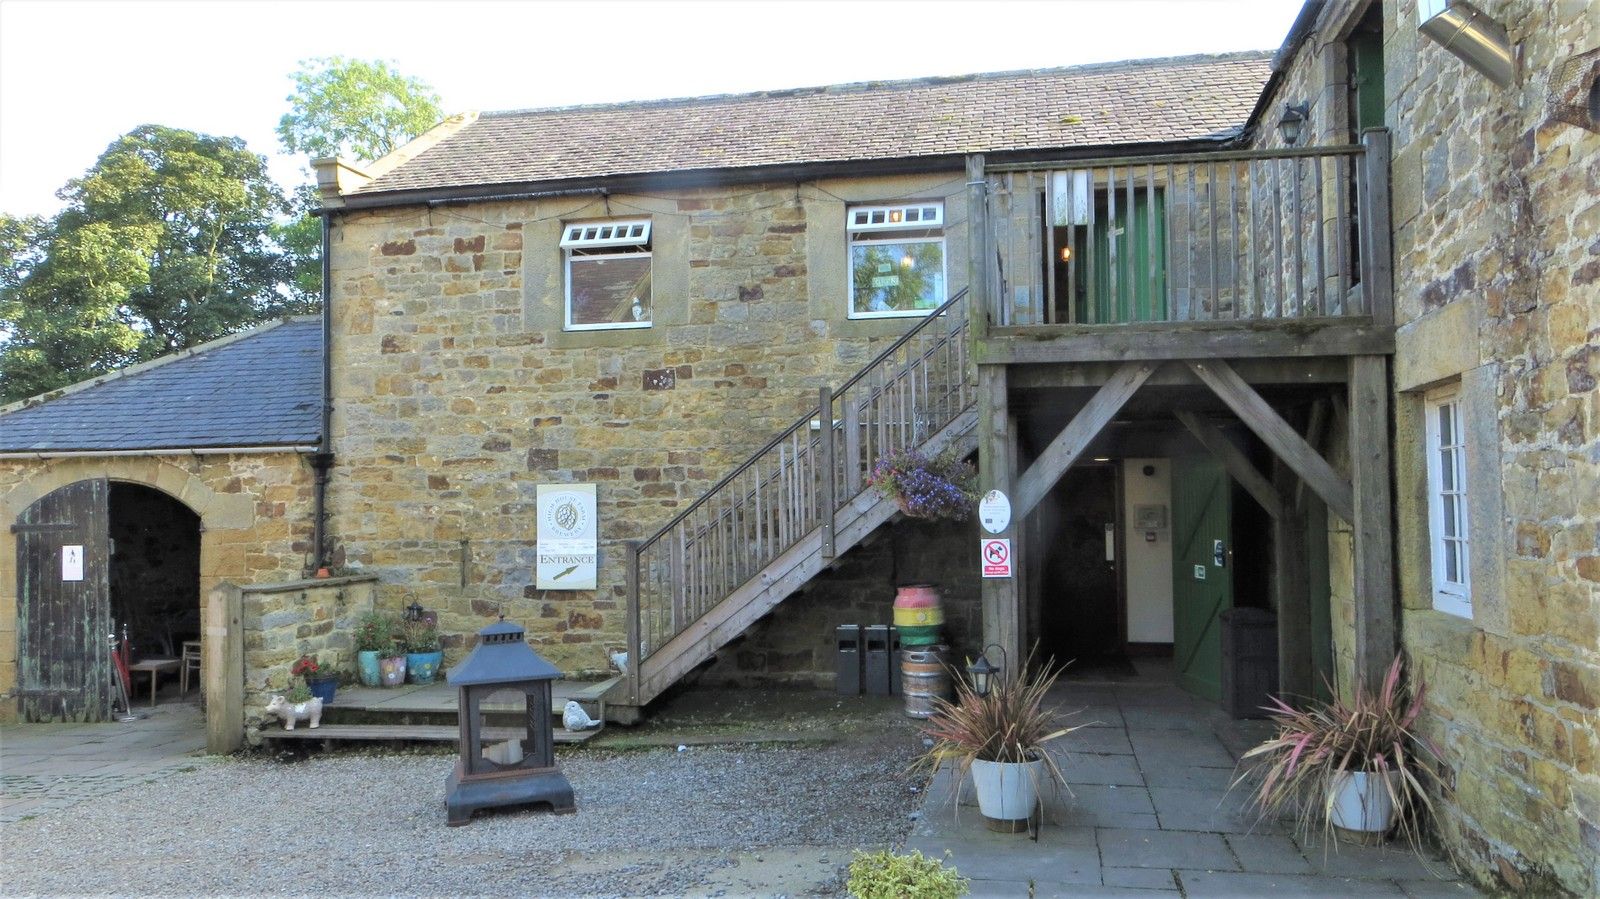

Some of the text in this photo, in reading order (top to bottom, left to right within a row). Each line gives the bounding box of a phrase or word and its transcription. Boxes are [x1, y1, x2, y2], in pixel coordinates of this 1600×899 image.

[555, 495, 576, 504] HOUSE
[577, 501, 586, 521] FARM
[551, 526, 583, 537] BREWERY
[540, 554, 594, 564] ENTRANCE
